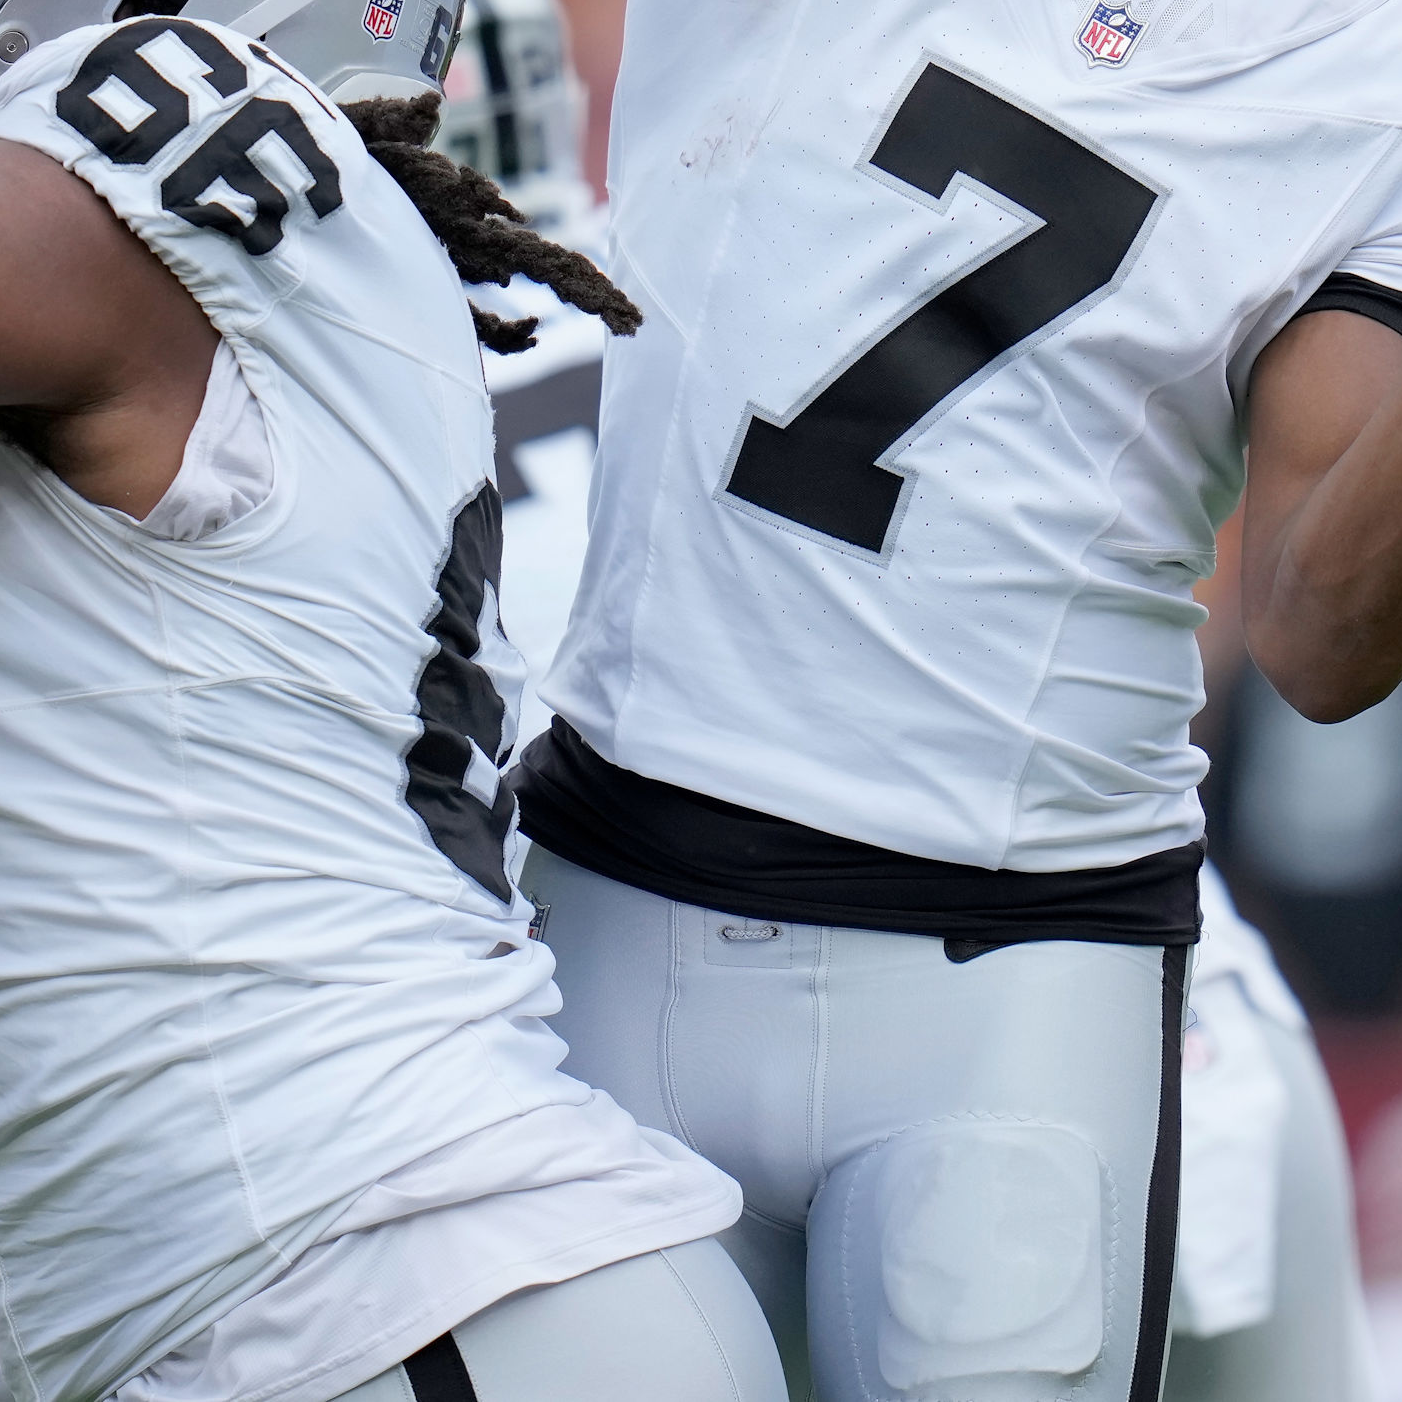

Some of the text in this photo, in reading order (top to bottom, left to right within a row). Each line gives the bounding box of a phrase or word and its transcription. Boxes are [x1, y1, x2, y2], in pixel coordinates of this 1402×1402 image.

[366, 5, 394, 36] NFL
[1083, 21, 1125, 59] NFL
[56, 18, 344, 258] 66
[713, 50, 1173, 569] 7
